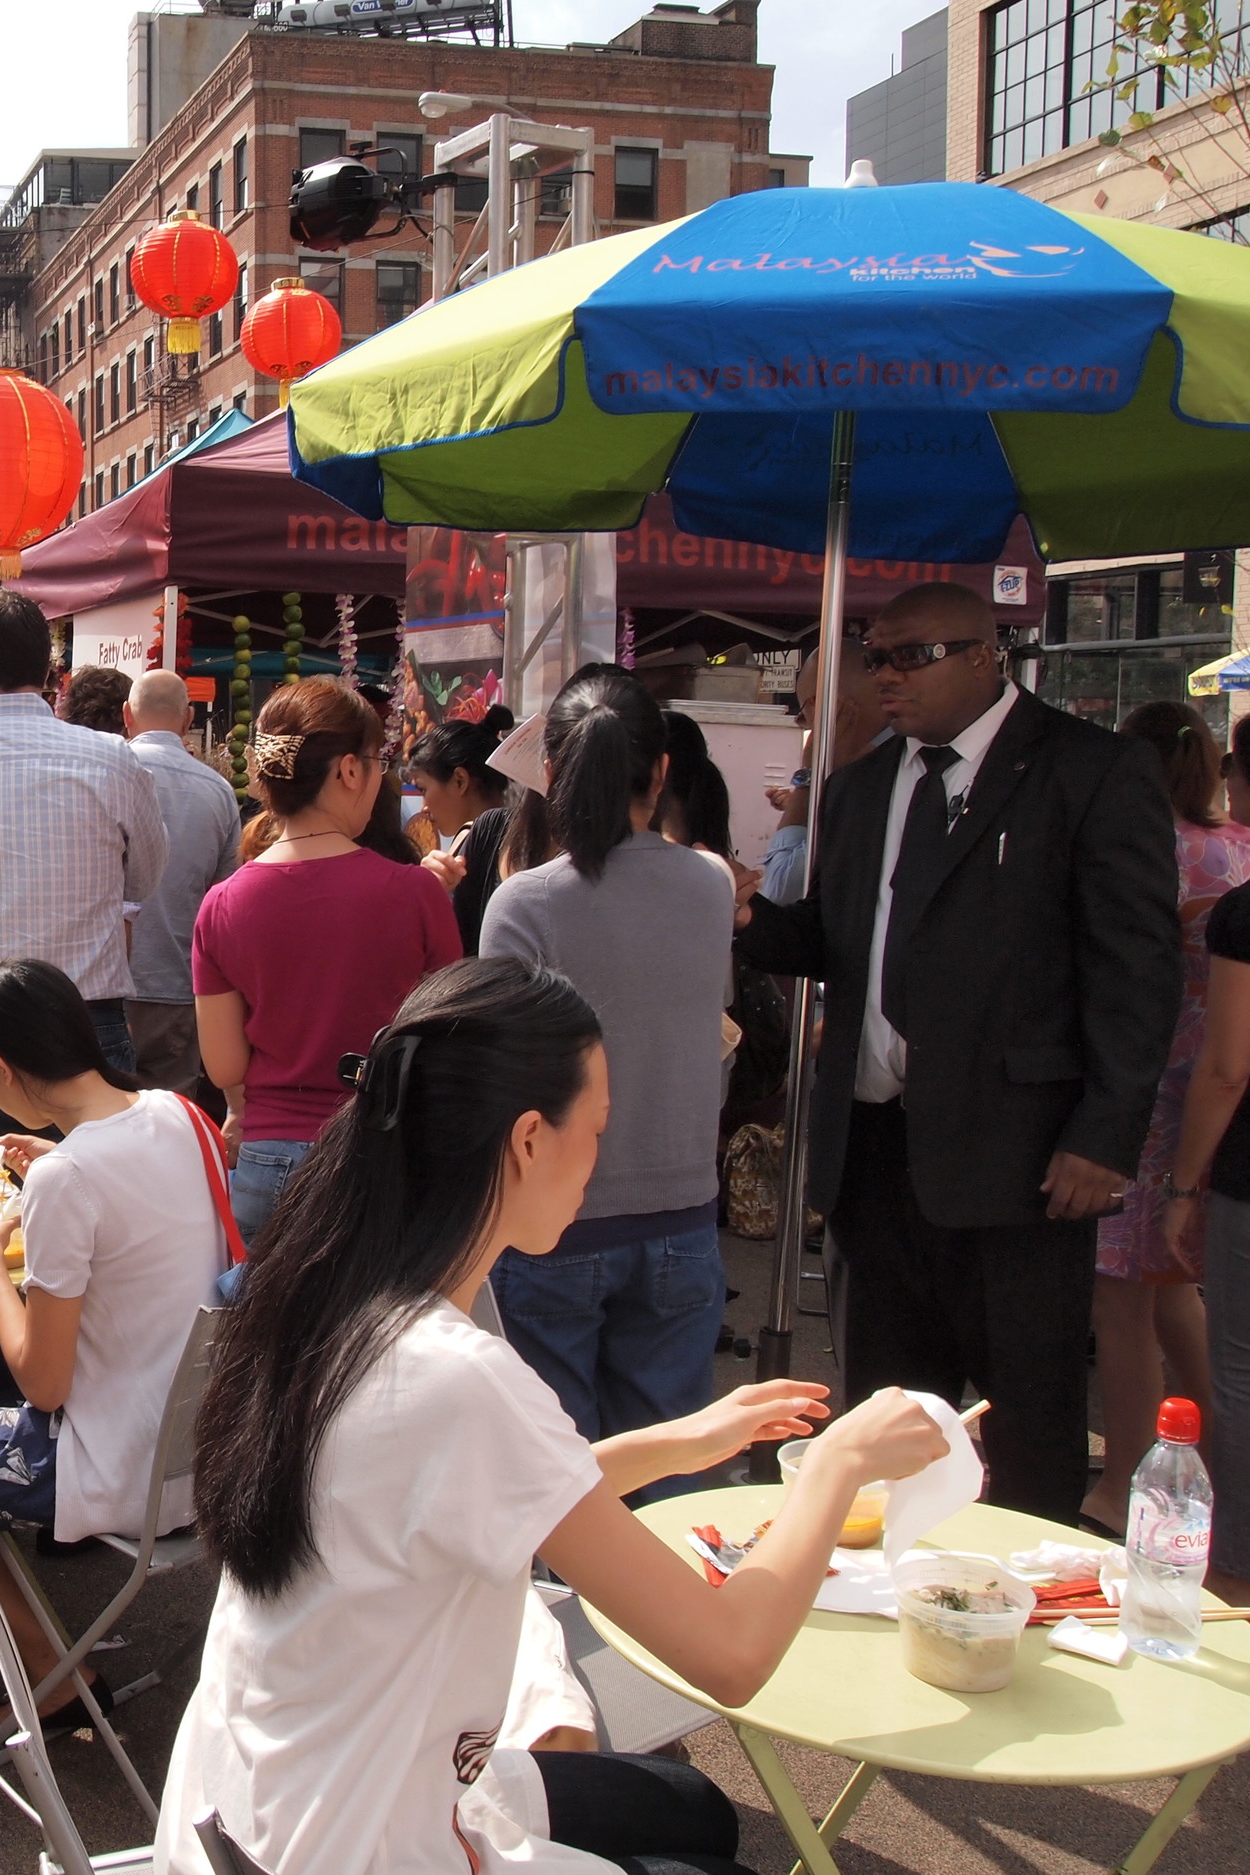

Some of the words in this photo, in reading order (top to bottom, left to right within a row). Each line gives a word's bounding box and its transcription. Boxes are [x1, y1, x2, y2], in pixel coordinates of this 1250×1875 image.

[653, 252, 969, 274] Malaysia
[850, 267, 976, 276] kitchen
[885, 273, 915, 281] the
[923, 272, 977, 280] world
[605, 355, 1120, 398] malaysiakitchennyc.com
[98, 642, 120, 668] Fatty
[122, 634, 143, 661] Crab
[756, 649, 791, 665] NLY
